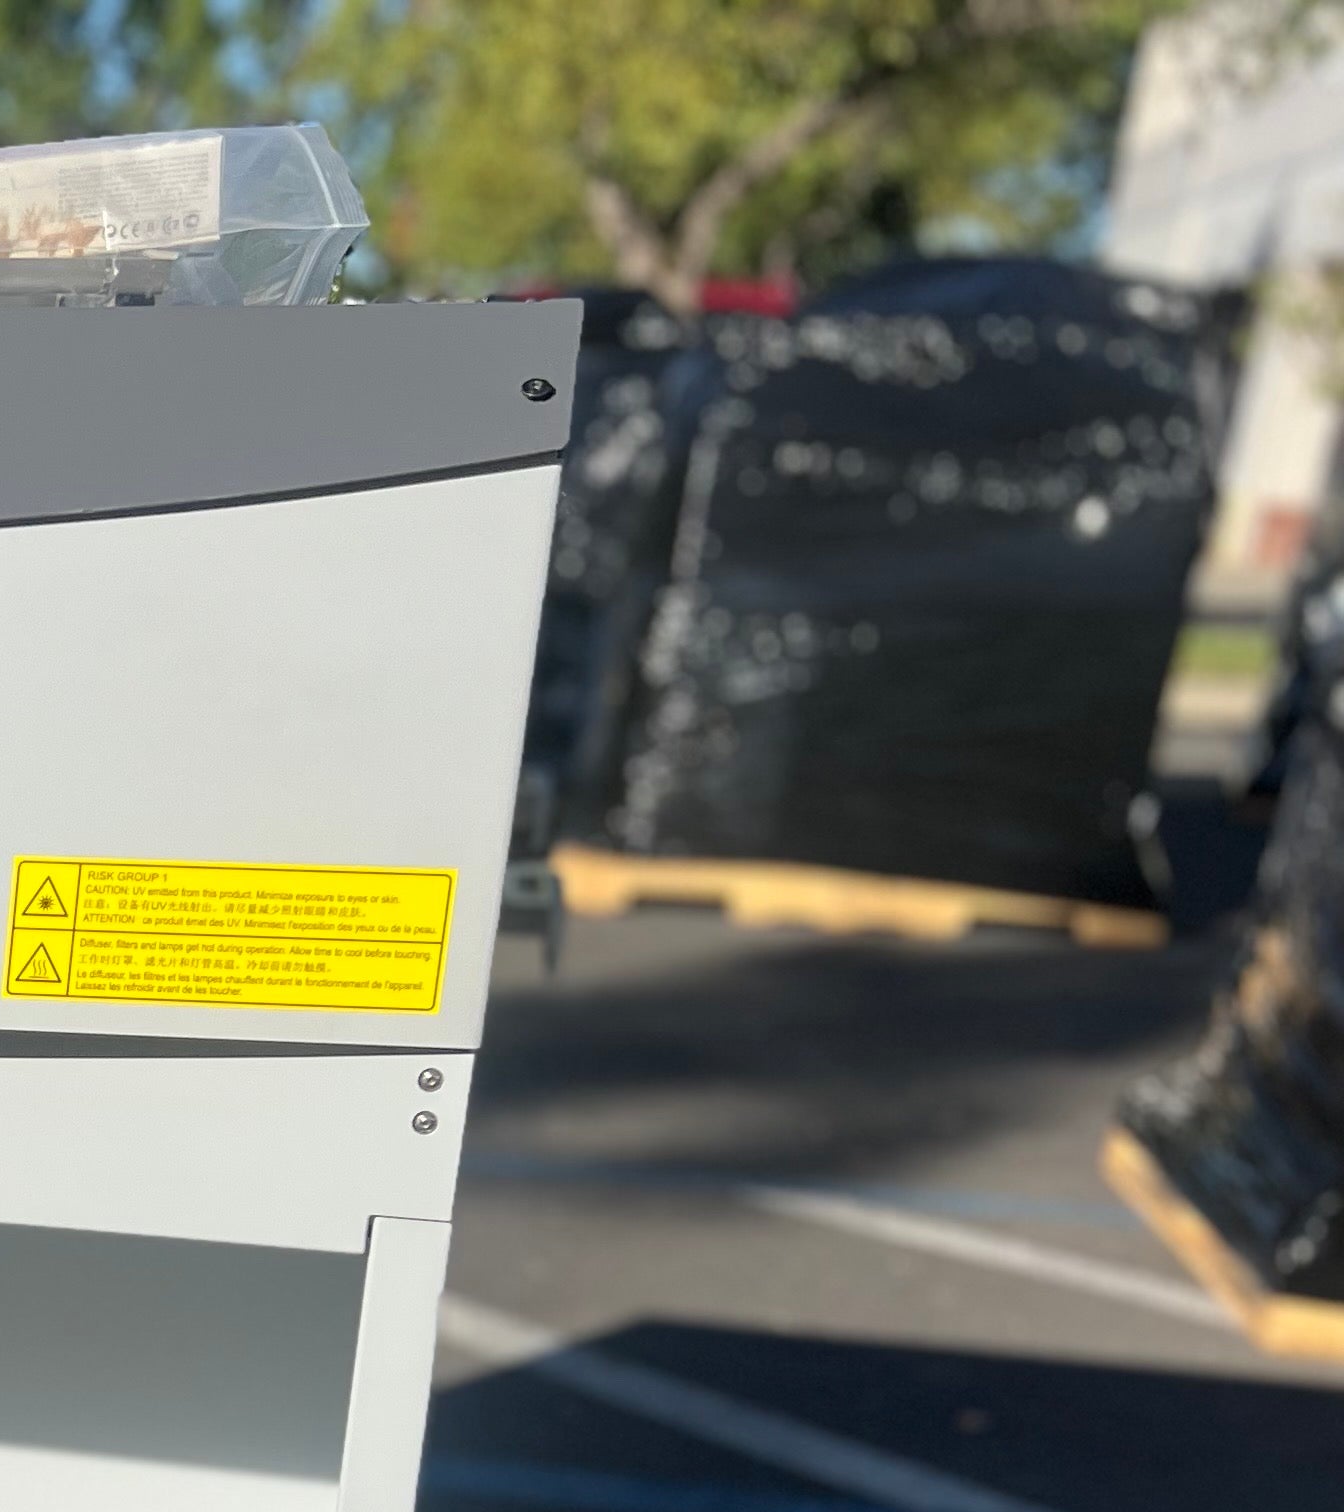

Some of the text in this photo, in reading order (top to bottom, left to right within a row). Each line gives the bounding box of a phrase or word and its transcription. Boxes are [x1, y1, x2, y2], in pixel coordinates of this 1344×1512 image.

[88, 870, 114, 880] RISK
[117, 871, 160, 882] GROUP
[132, 886, 146, 895] UV
[148, 888, 179, 896] emitted
[181, 888, 200, 897] from
[203, 889, 217, 898] this
[295, 893, 334, 903] exposure
[337, 894, 345, 902] to
[347, 896, 368, 904] eyes
[209, 918, 224, 927] des
[337, 922, 353, 931] des
[355, 925, 375, 934] yeux
[390, 923, 401, 933] de
[403, 924, 411, 933] la
[116, 939, 138, 949] filters
[140, 941, 156, 950] and
[158, 942, 183, 952] lamps
[186, 943, 199, 953] get
[201, 944, 215, 952] hot
[217, 944, 243, 955] during
[289, 946, 312, 955] Allow
[314, 947, 332, 956] time
[334, 948, 343, 956] to
[345, 949, 362, 957] cool
[365, 949, 392, 958] before
[75, 981, 107, 991] Laissez
[109, 982, 120, 991] les
[123, 983, 155, 992] refroidir
[157, 985, 180, 993] avant
[182, 984, 193, 993] de
[195, 985, 207, 994] les
[76, 969, 87, 978] Le
[129, 971, 141, 980] les
[143, 972, 165, 981] filtres
[178, 973, 190, 982] les
[193, 974, 222, 984] lampes
[225, 975, 264, 984] chauffent
[266, 977, 293, 985] durant
[295, 977, 302, 986] le
[305, 977, 370, 988] fonctionnement
[371, 980, 382, 989] de
